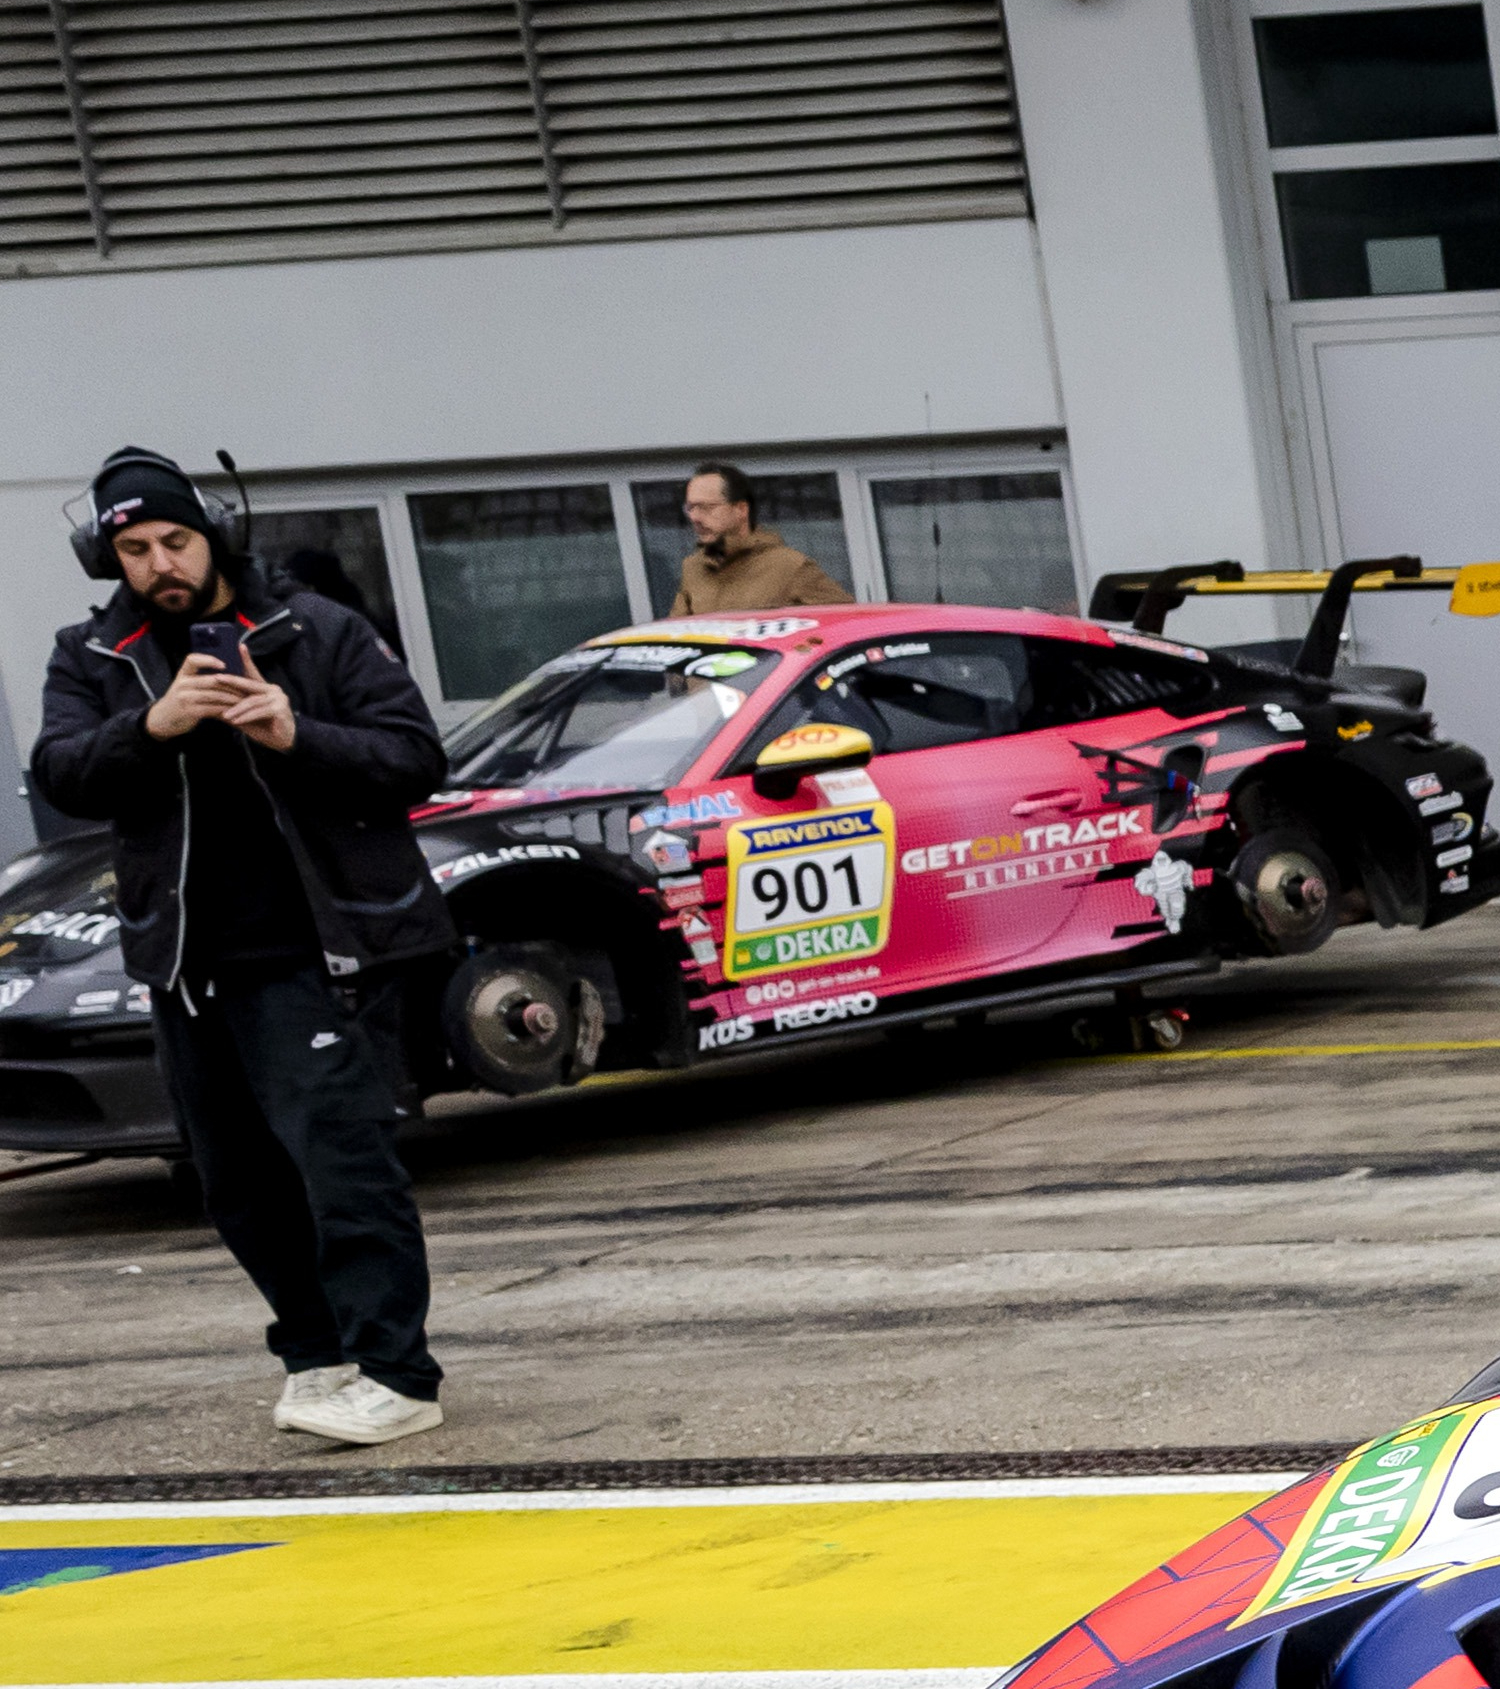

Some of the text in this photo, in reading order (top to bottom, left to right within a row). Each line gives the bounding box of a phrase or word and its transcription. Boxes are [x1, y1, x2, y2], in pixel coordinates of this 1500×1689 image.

[752, 816, 871, 848] RAVENOL
[432, 844, 581, 884] FALKEN
[752, 854, 862, 922] 901
[775, 920, 870, 962] DEKRA
[774, 991, 878, 1031] RECARO
[1279, 1464, 1423, 1601] DEKRA
